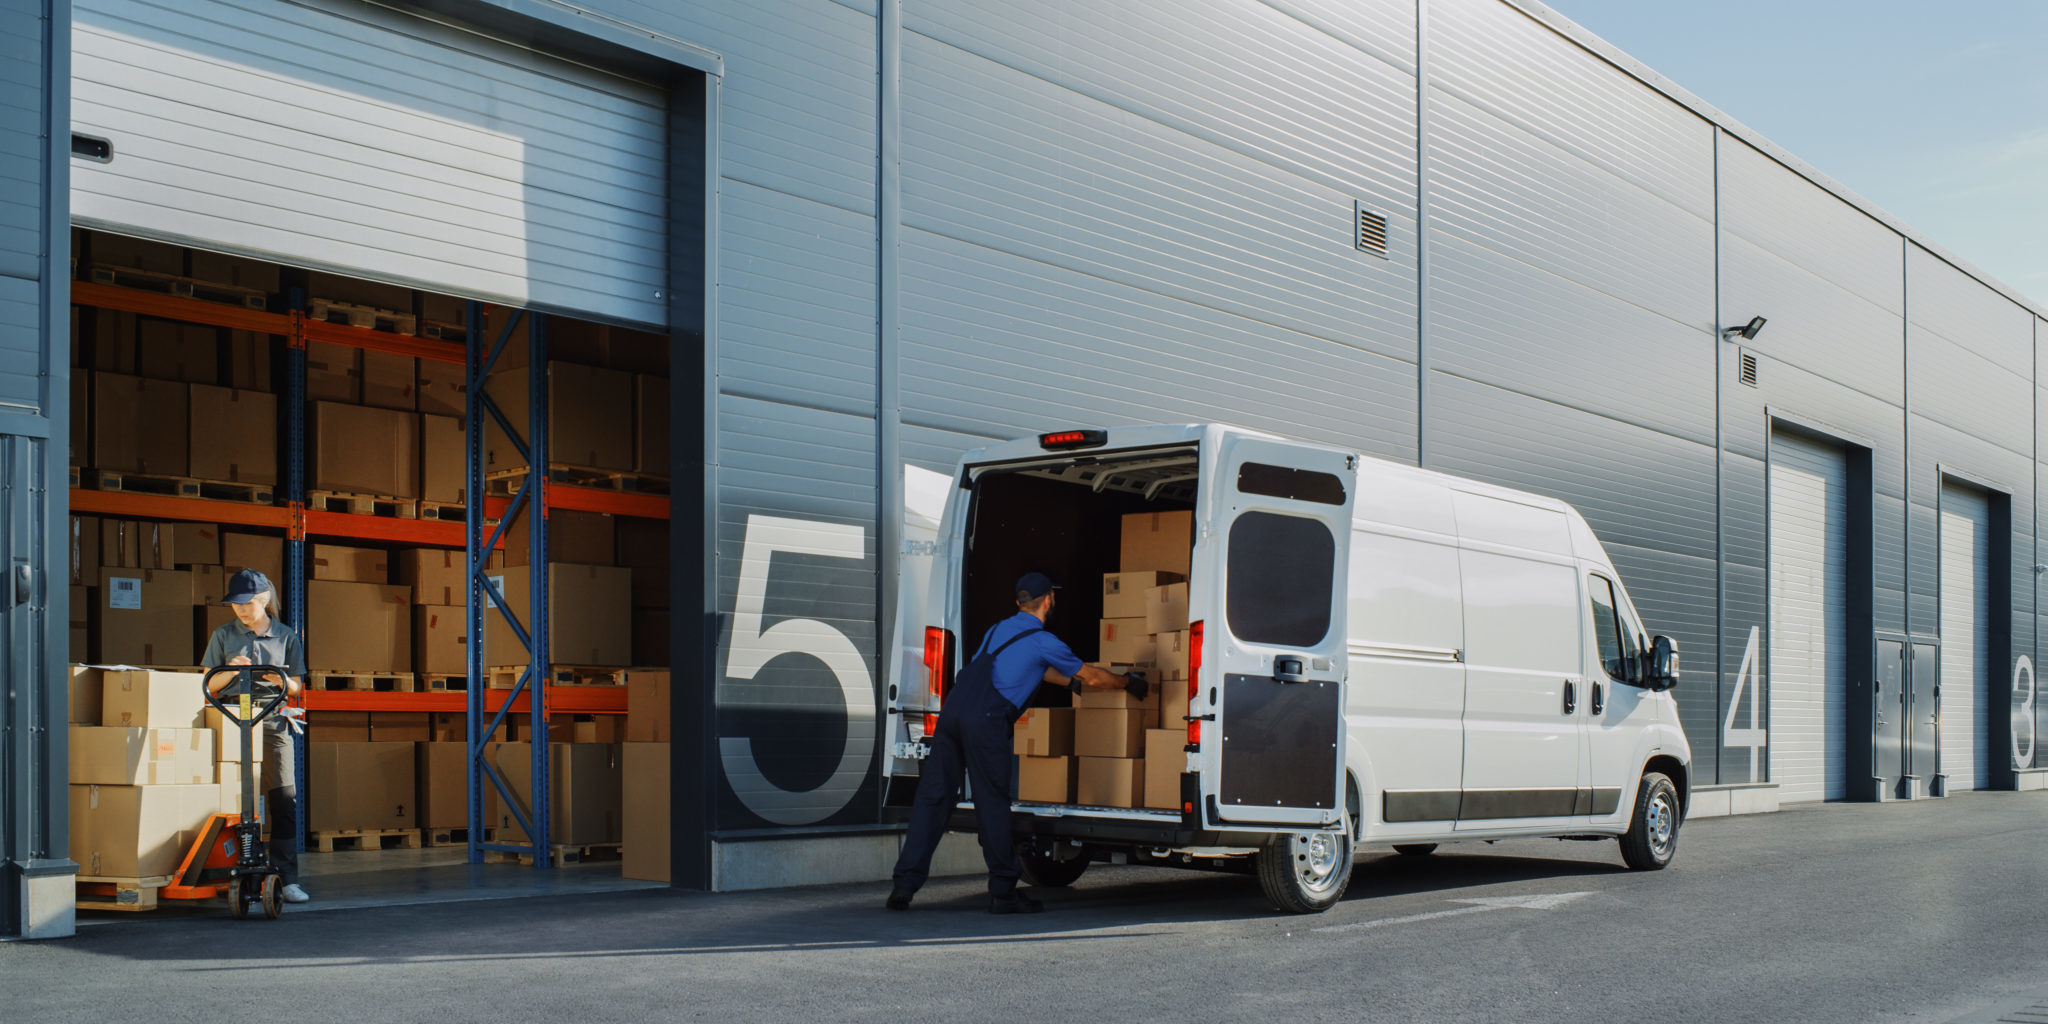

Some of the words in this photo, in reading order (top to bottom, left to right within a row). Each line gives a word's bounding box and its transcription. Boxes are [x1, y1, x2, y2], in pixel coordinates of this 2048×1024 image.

[719, 514, 876, 825] 5
[1723, 626, 1766, 782] 4
[2012, 654, 2034, 768] 3
